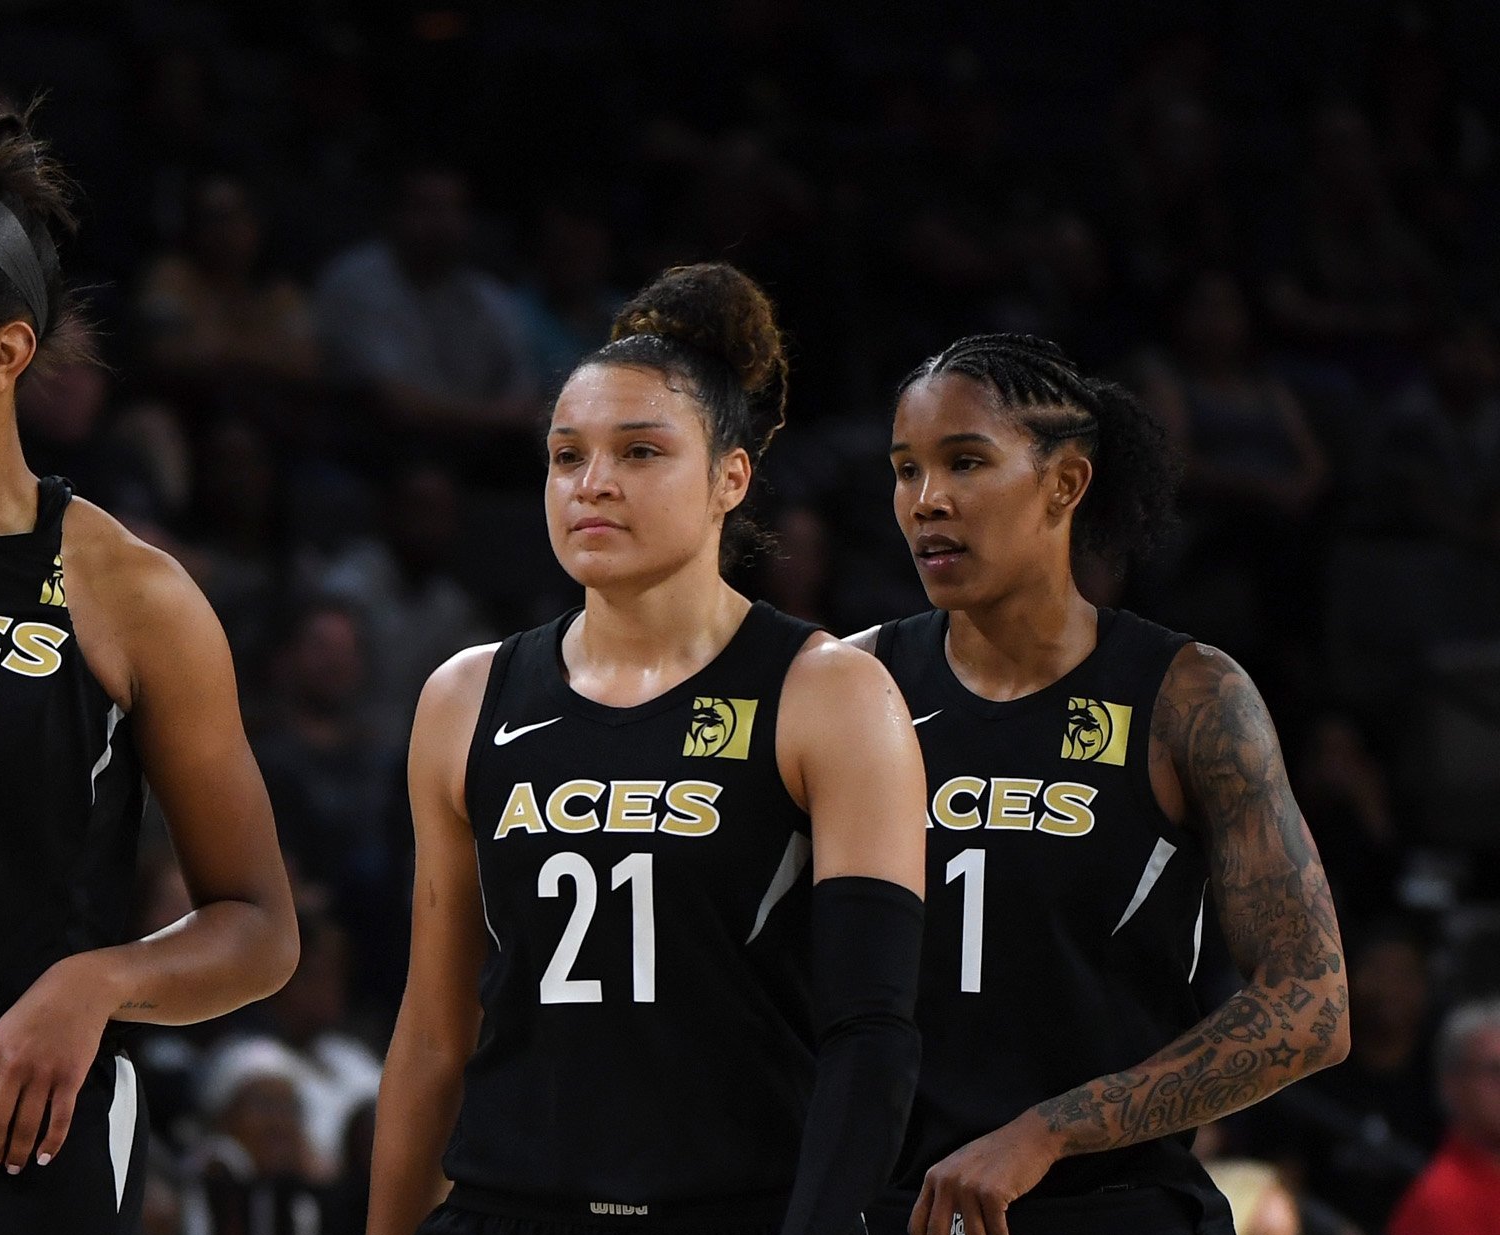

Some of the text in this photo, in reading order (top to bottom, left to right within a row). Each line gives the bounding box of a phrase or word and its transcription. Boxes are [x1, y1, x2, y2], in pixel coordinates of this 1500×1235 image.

[493, 779, 724, 841] ACES
[925, 775, 1099, 837] CES
[537, 851, 656, 1005] 21
[945, 848, 986, 993] 1
